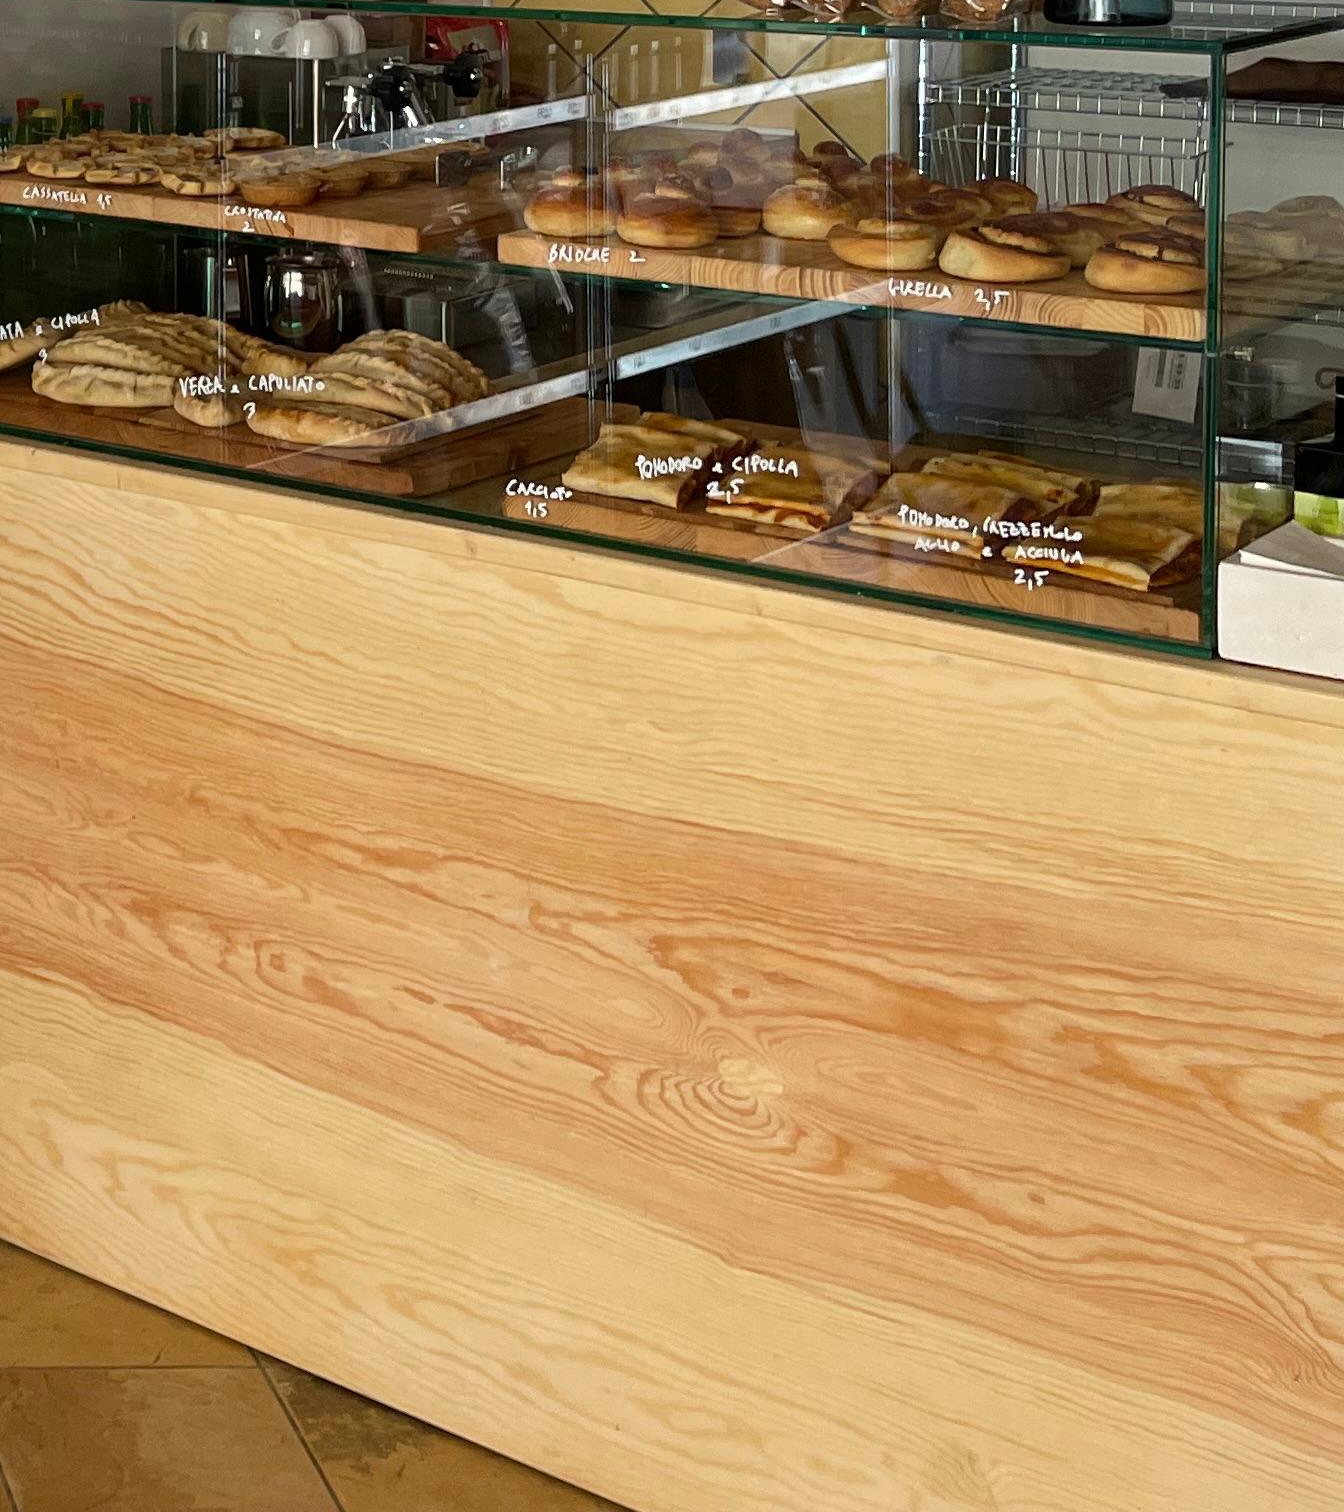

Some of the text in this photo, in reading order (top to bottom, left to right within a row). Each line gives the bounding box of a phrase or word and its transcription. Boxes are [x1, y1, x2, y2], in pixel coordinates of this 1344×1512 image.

[22, 185, 88, 206] CASSATELLA
[224, 205, 287, 225] CROSTATINA
[242, 221, 254, 233] 2
[548, 243, 647, 266] BRIOCHE 2
[887, 278, 953, 301] GIRELLA
[50, 308, 100, 330] CIPOLLA
[179, 377, 226, 398] VERZA
[248, 374, 326, 394] CAPULIATO
[243, 402, 256, 419] 3
[634, 454, 703, 480] POMODORO
[732, 454, 799, 477] CIPOLLA
[914, 536, 961, 554] AGLIO
[1014, 543, 1085, 566] ACCIUGA
